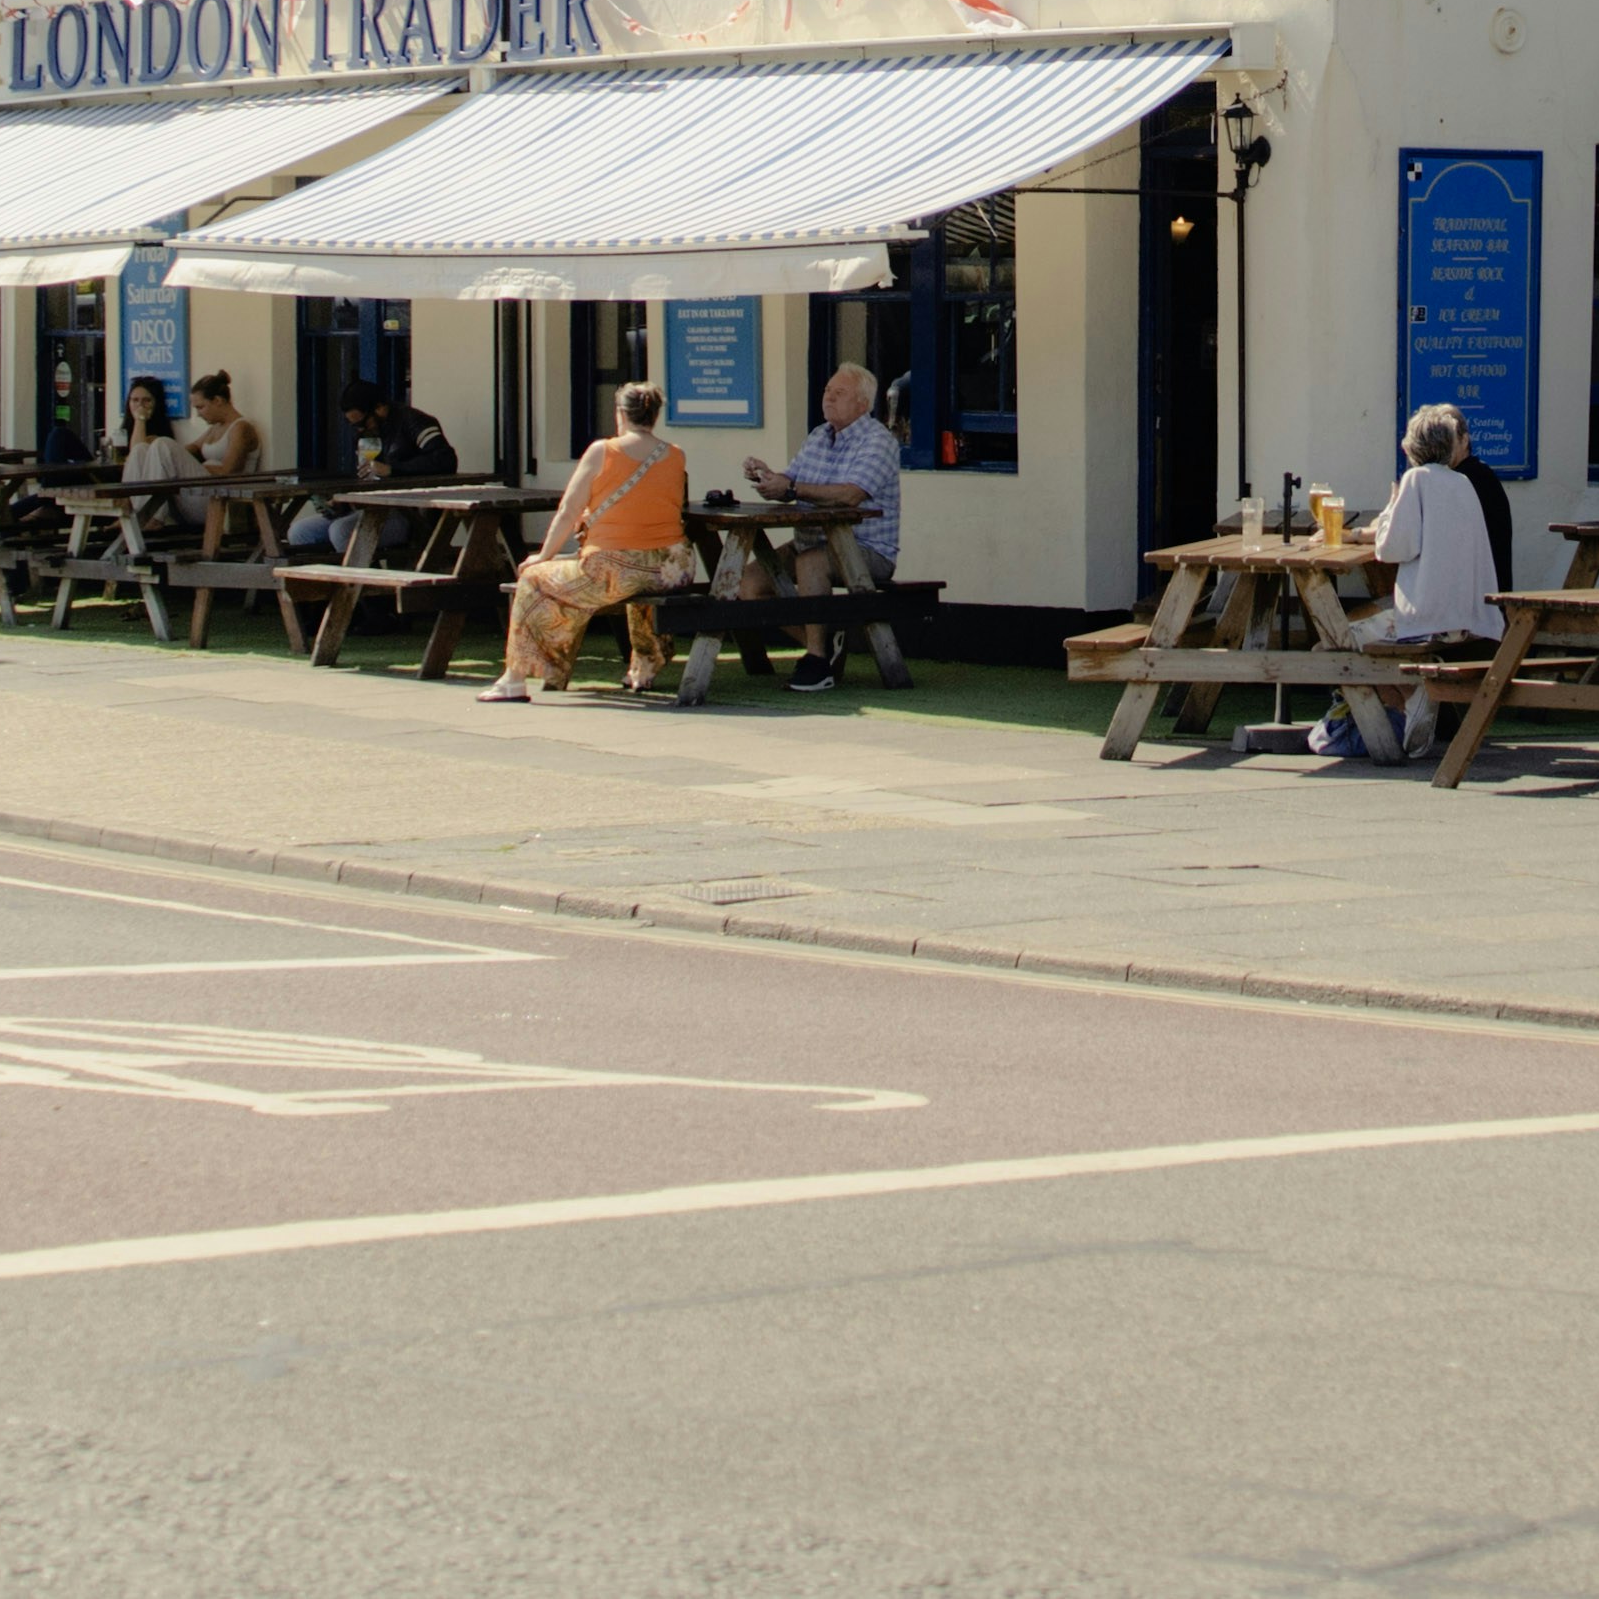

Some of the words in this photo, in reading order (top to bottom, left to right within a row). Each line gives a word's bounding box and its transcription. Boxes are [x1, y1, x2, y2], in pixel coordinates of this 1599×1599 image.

[1433, 216, 1508, 233] TRADITIONAL
[1430, 237, 1483, 254] SEAFOOD
[1485, 238, 1511, 254] BAR
[127, 283, 178, 309] Saturday
[1439, 308, 1456, 322] ICE
[1461, 308, 1500, 323] CREAM
[130, 319, 176, 346] DISCO
[1414, 335, 1463, 354] QUALITY
[134, 346, 173, 365] NIGHTS
[1430, 364, 1454, 378] HOT
[1456, 364, 1507, 378] SEAFOOD
[1457, 384, 1480, 399] BAR
[1482, 430, 1513, 444] Drinks
